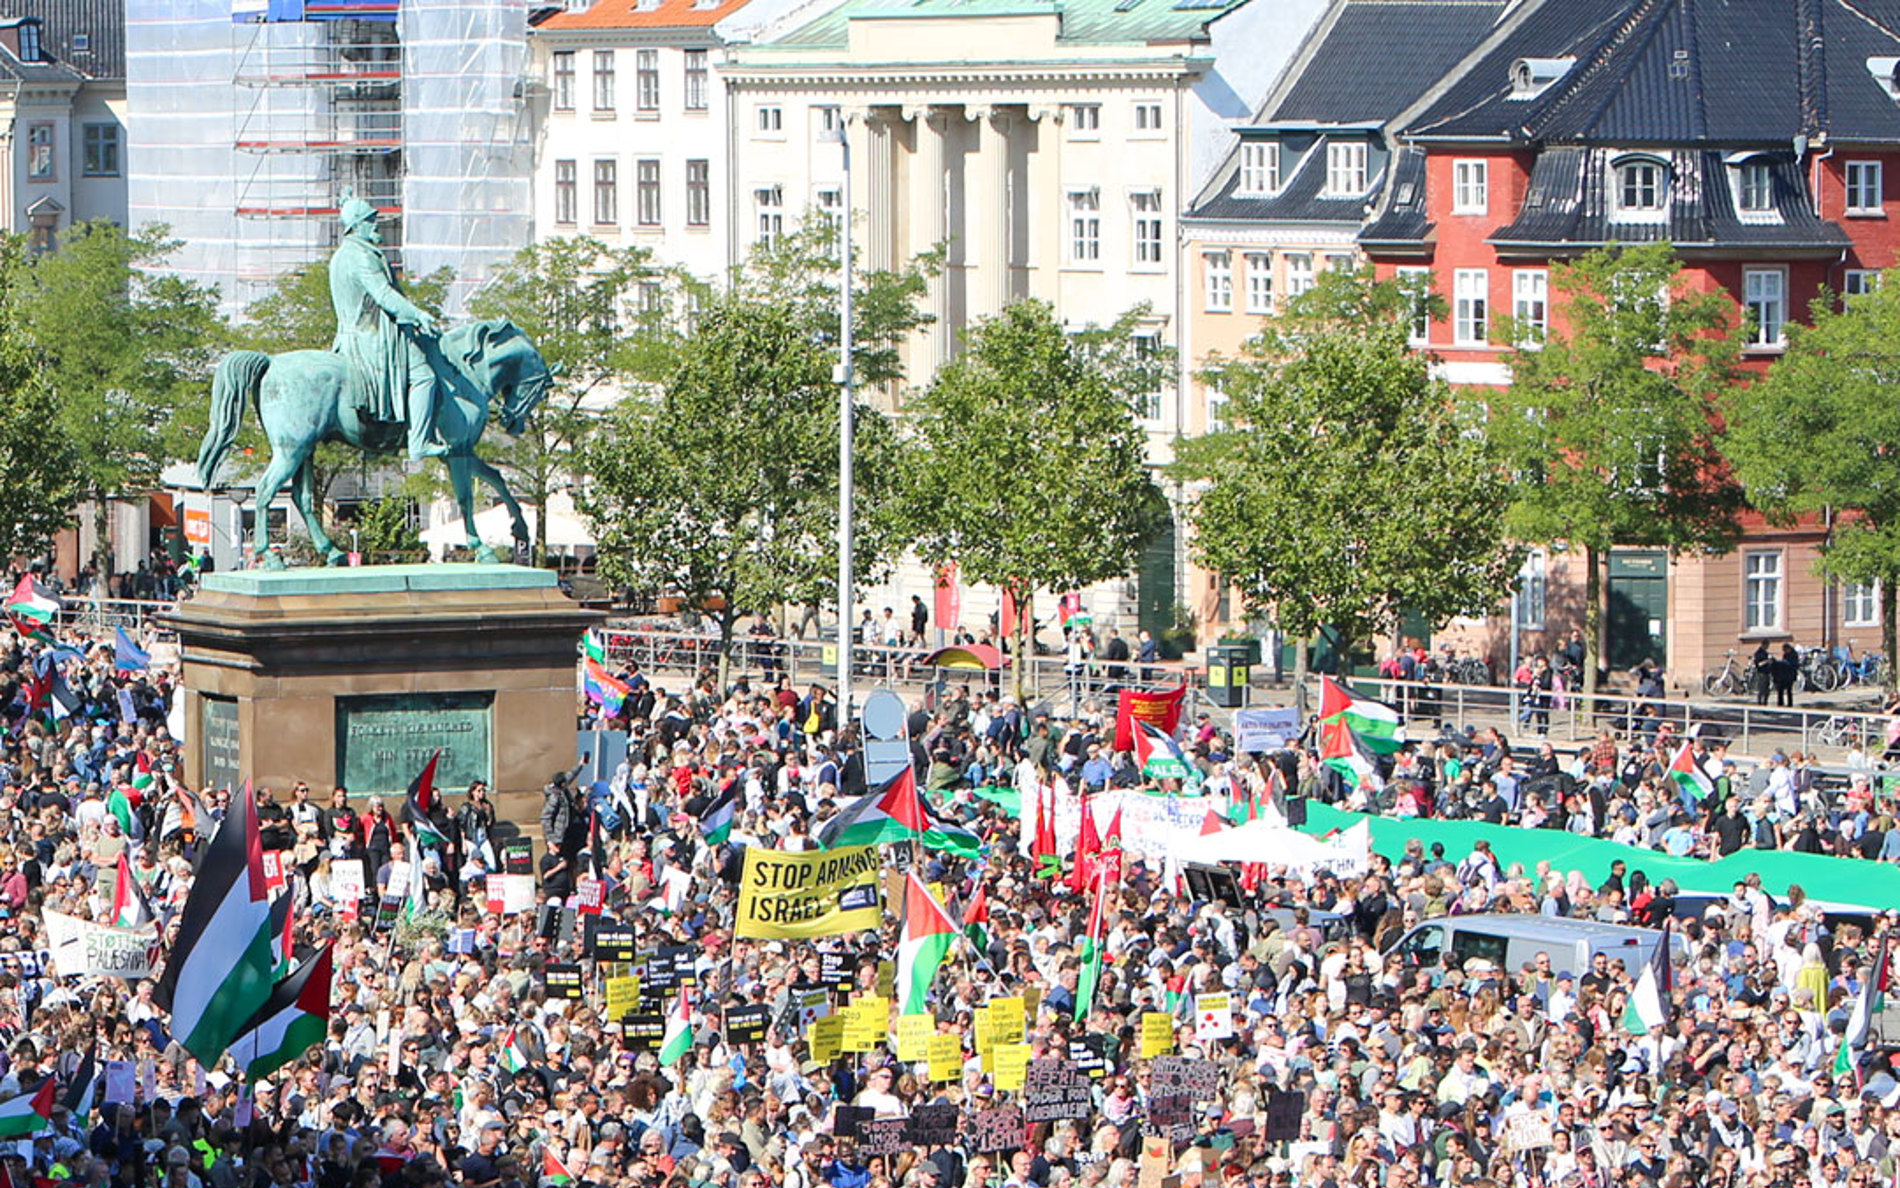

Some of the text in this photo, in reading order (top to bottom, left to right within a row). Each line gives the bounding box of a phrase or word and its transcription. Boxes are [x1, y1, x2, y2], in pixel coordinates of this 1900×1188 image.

[516, 540, 525, 555] P
[754, 846, 877, 890] STOP ARMING
[749, 896, 826, 923] ISRAEL
